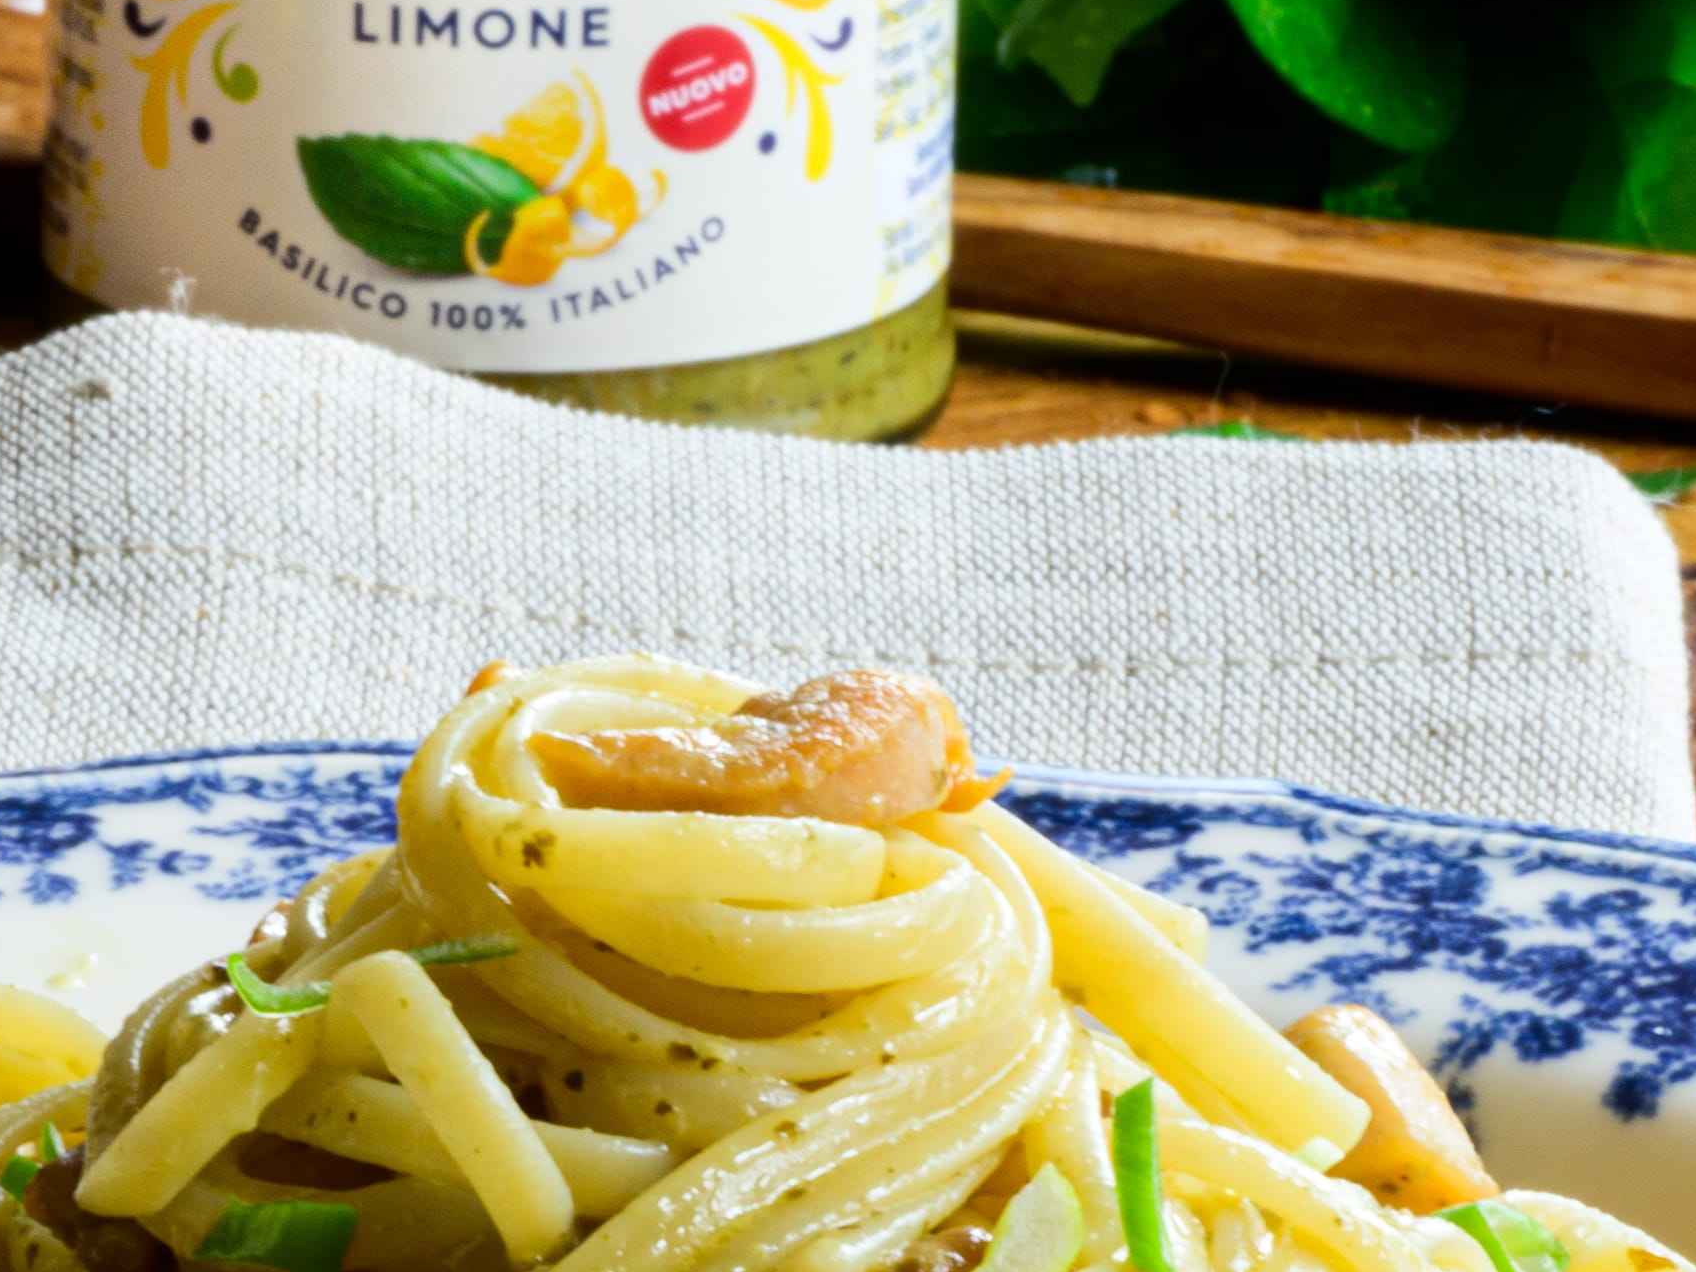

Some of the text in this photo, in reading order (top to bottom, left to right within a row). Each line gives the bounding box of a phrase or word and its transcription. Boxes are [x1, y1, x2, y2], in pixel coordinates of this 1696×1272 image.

[354, 2, 612, 49] LIMONE
[648, 61, 749, 117] NUOVO
[238, 207, 727, 331] BASILICO 100% ITALIANO
